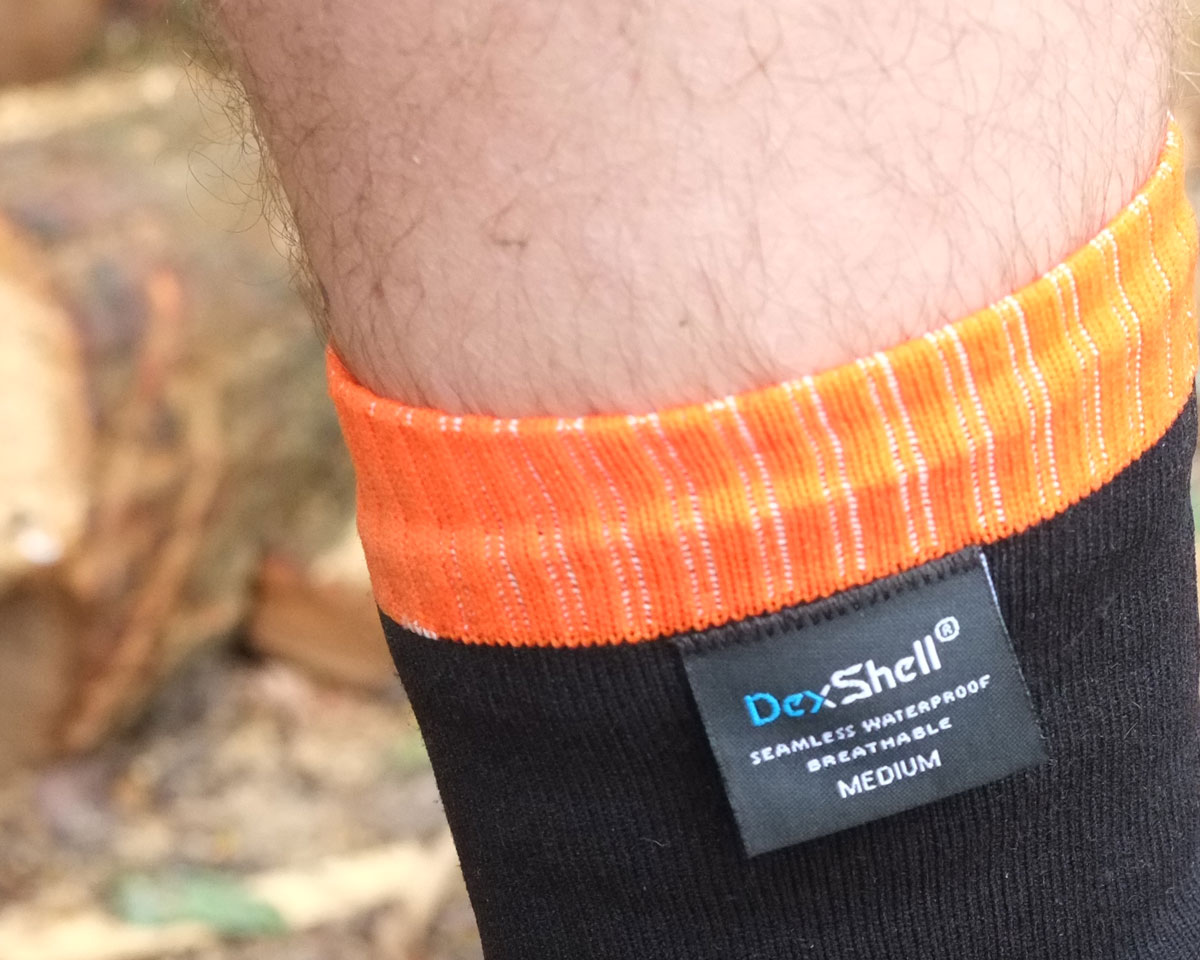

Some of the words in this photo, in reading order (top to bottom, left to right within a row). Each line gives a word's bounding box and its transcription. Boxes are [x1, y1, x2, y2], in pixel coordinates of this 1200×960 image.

[749, 724, 857, 766] SEAMLESS
[862, 673, 992, 733] WATERPROOF
[806, 716, 953, 773] BREATHABLE
[836, 749, 943, 799] MEDIUM
